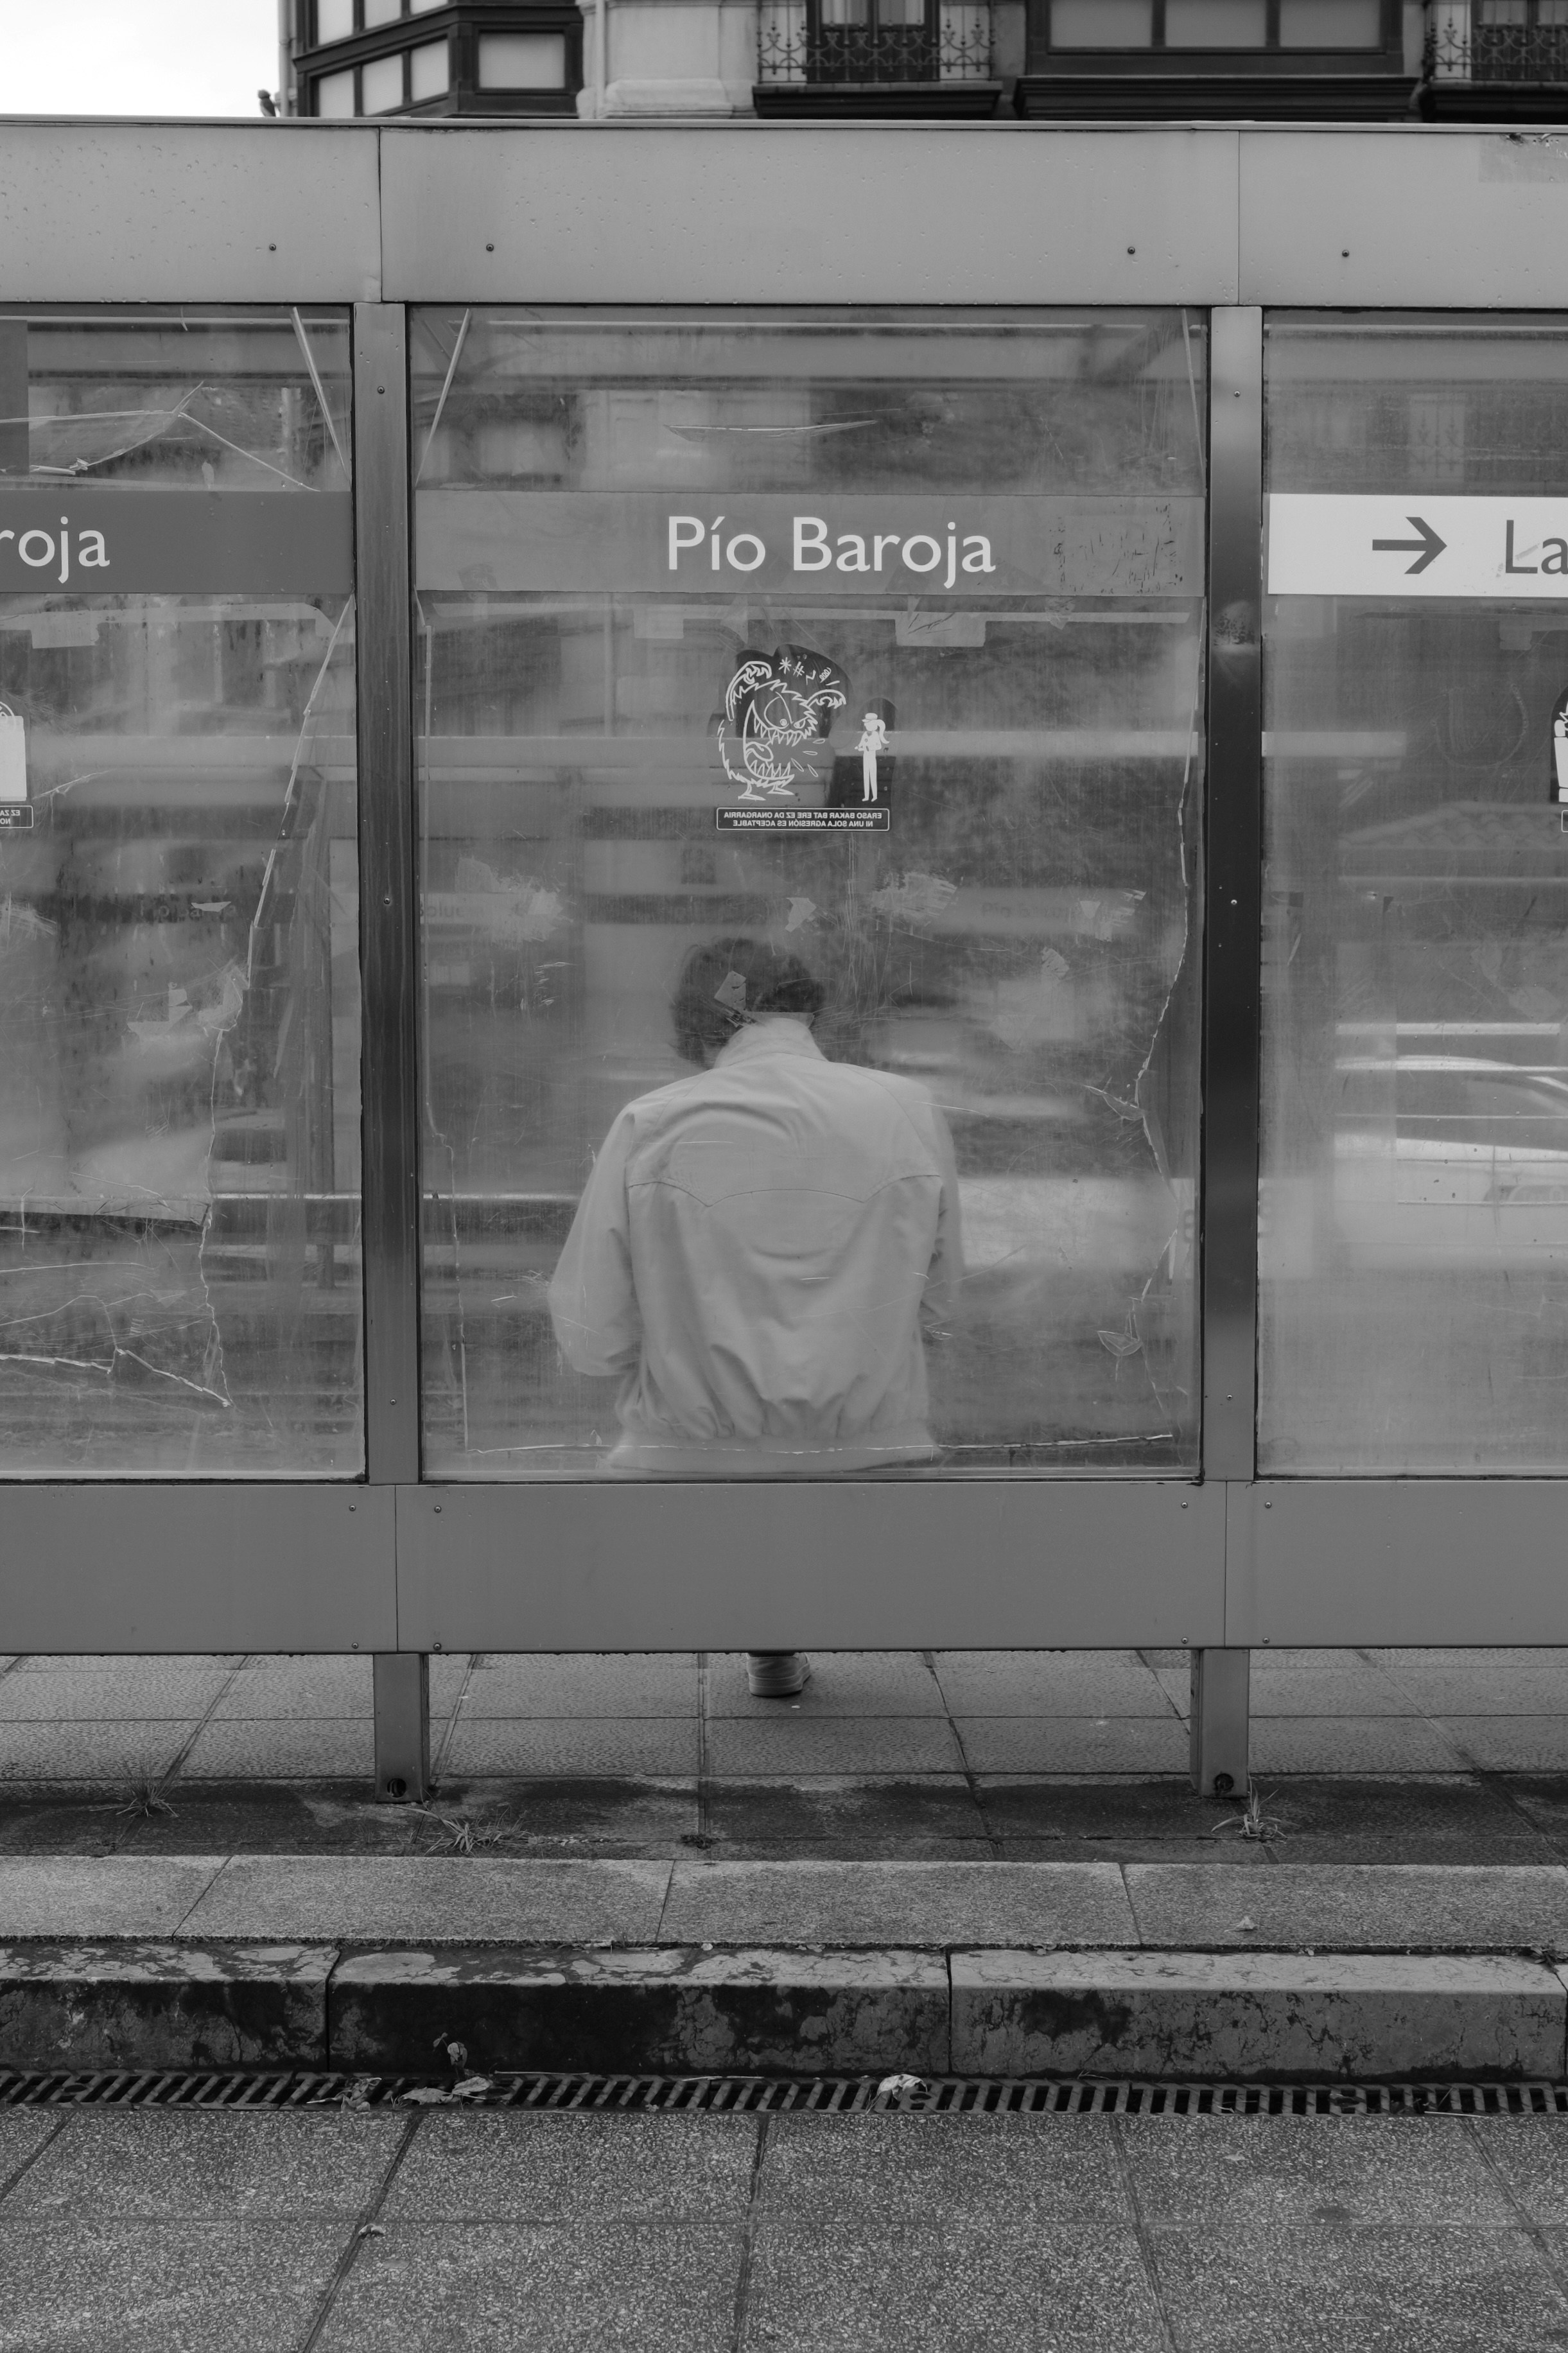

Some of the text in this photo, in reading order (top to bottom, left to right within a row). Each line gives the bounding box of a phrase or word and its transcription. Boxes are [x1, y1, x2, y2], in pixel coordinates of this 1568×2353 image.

[669, 516, 996, 589] Pío Baroja
[1505, 520, 1568, 575] La
